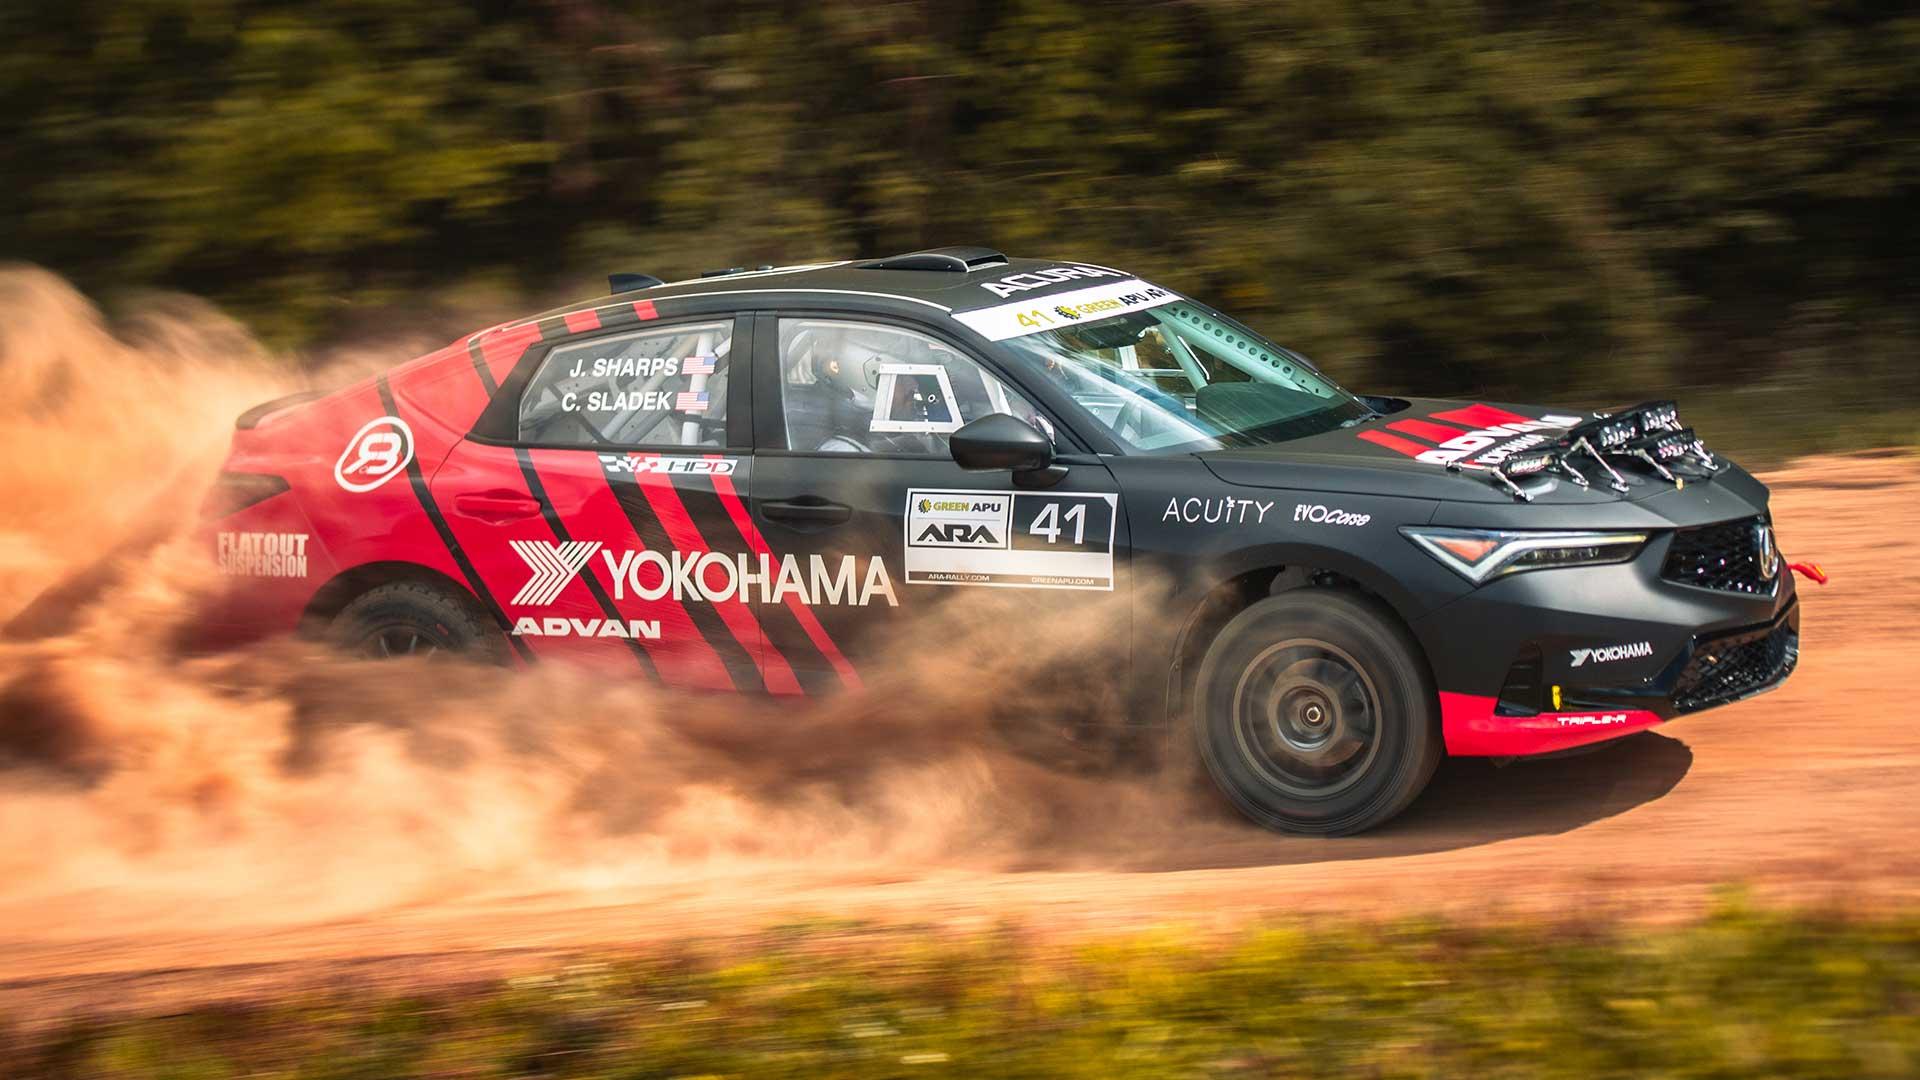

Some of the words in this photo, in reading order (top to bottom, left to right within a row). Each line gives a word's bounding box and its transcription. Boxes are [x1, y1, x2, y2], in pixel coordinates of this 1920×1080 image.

[981, 266, 1121, 299] ACURA
[1016, 309, 1056, 328] 41
[1075, 298, 1123, 314] GREEN
[1118, 292, 1149, 306] APU
[569, 358, 586, 378] J.
[592, 357, 679, 377] SHARPS
[562, 392, 581, 412] C.
[587, 391, 673, 411] SLADEK
[1415, 415, 1583, 464] ADVAN
[668, 461, 734, 473] HPD
[933, 501, 969, 512] GREEN
[971, 503, 1001, 513] APU
[916, 523, 999, 544] ARA
[1029, 503, 1086, 545] 41
[217, 532, 309, 555] FLATOUT
[219, 554, 308, 578] SUSPENSION
[601, 549, 899, 607] YOKOHAMA
[928, 573, 990, 582] ARA-RALLY.COM
[1031, 576, 1095, 586] GREENAPU.COM
[511, 616, 661, 639] ADVAN
[1591, 641, 1653, 663] YOKOHAMA
